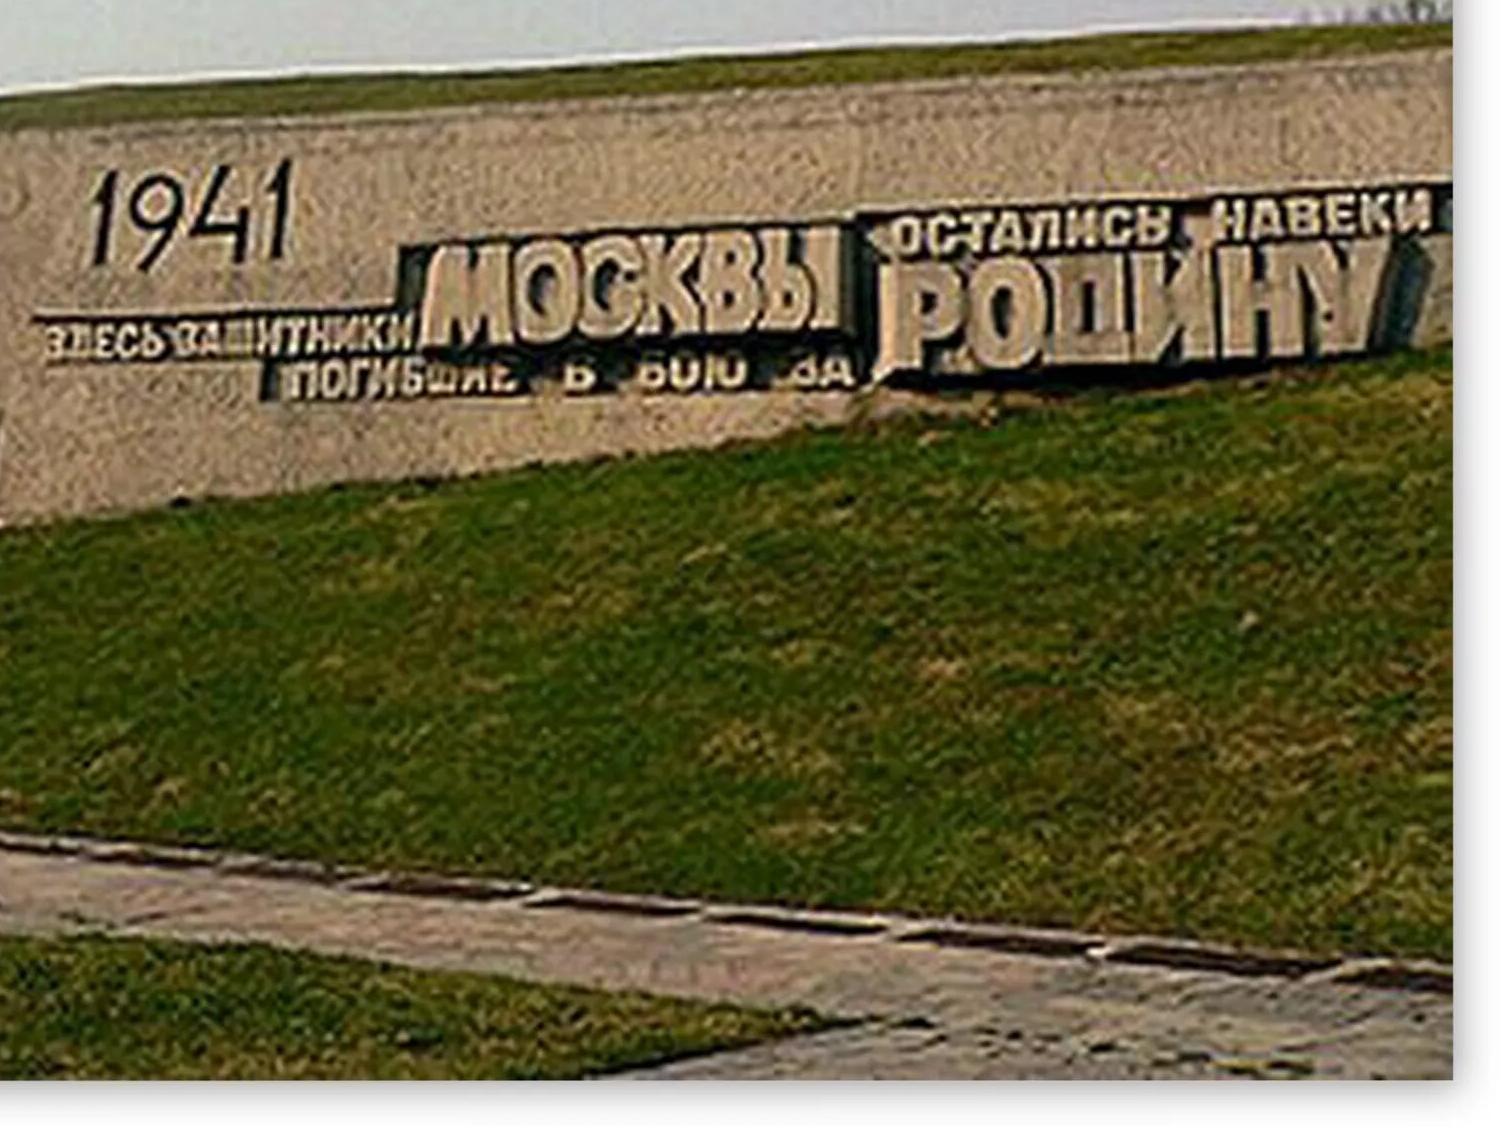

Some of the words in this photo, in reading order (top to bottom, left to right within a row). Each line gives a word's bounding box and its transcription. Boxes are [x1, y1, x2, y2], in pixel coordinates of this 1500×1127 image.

[45, 322, 165, 360] ЗДЕСЬ
[421, 227, 841, 345] МОСКВЫ
[896, 205, 1173, 254] ОСТАЛИСЬ
[1212, 189, 1433, 241] НАВЕКИ
[92, 157, 292, 272] 1941
[288, 355, 518, 399] ПОГИБШИЕ
[876, 239, 1389, 371] РОДИНУ
